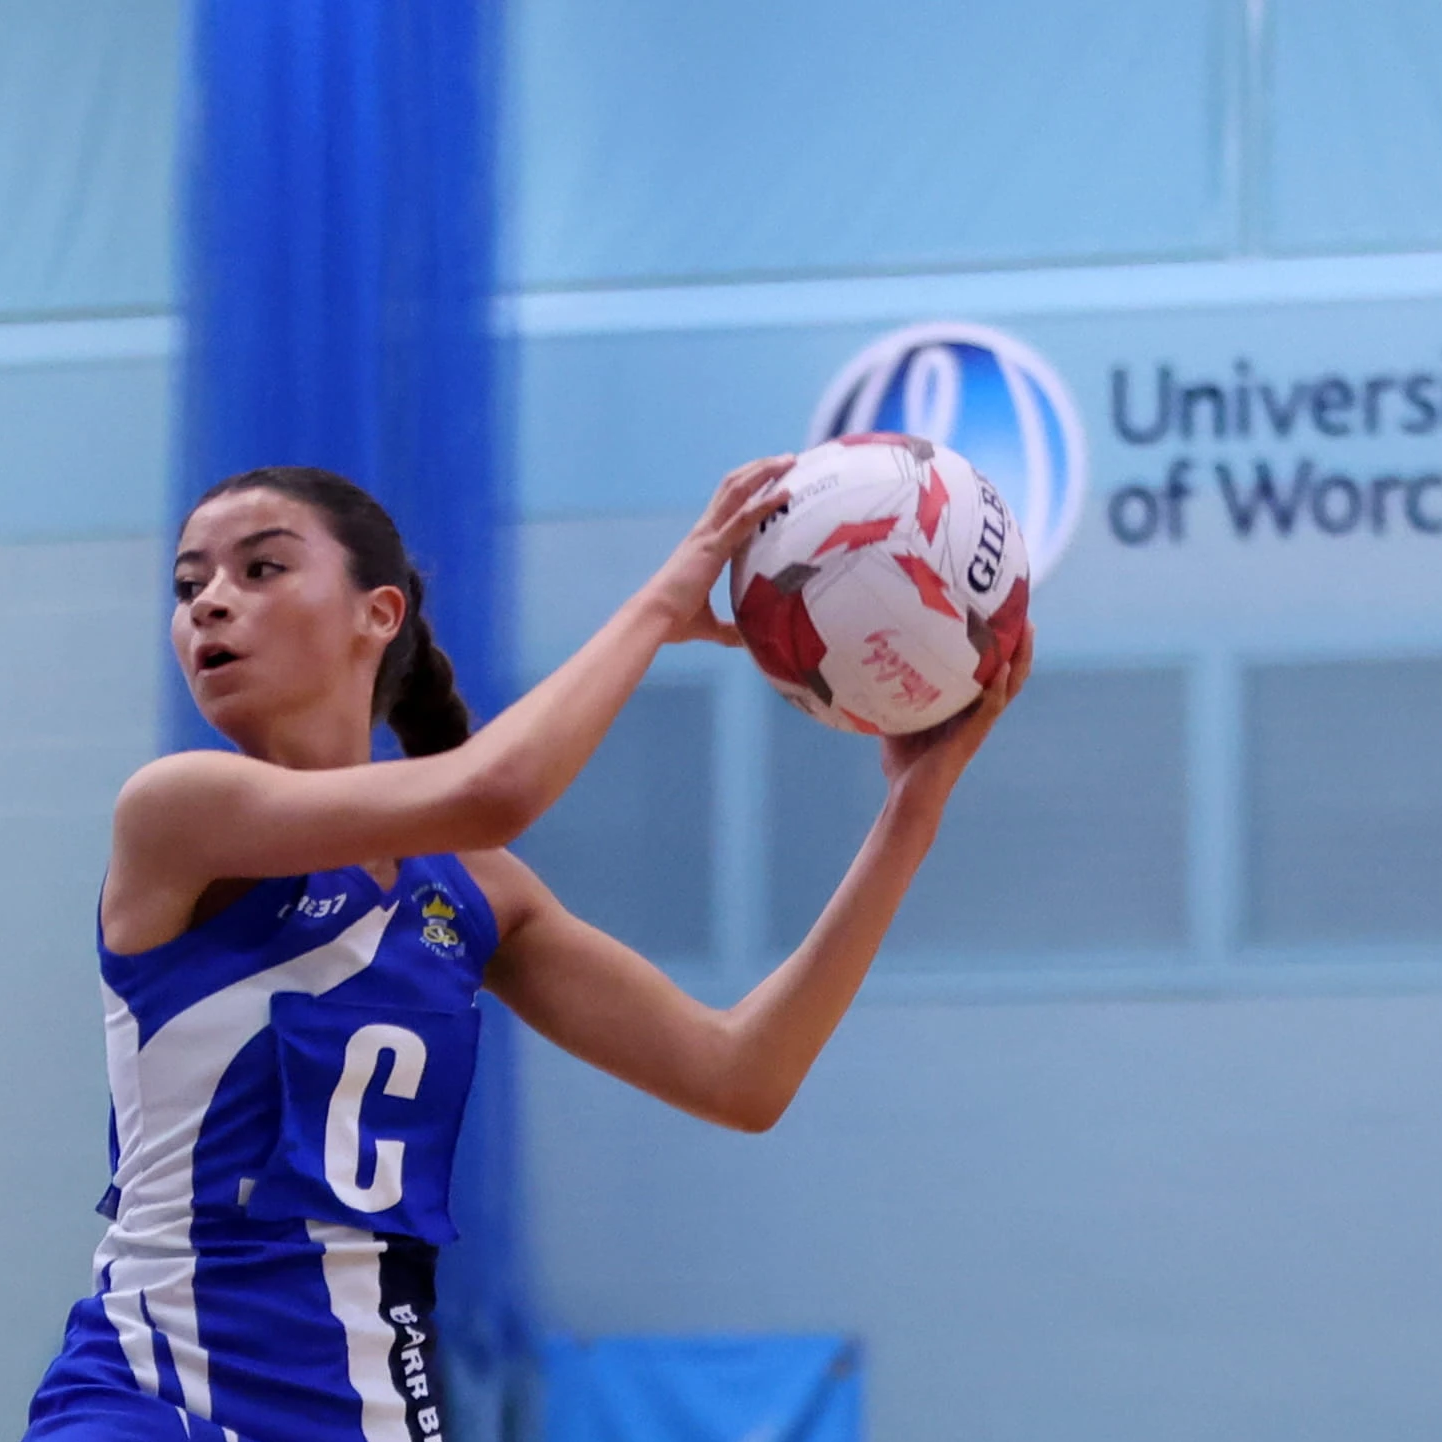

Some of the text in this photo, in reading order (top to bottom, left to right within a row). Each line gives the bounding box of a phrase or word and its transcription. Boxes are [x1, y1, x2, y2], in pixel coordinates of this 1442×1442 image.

[1108, 464, 1195, 546] of
[324, 1023, 428, 1214] C
[389, 1304, 430, 1399] BARR
